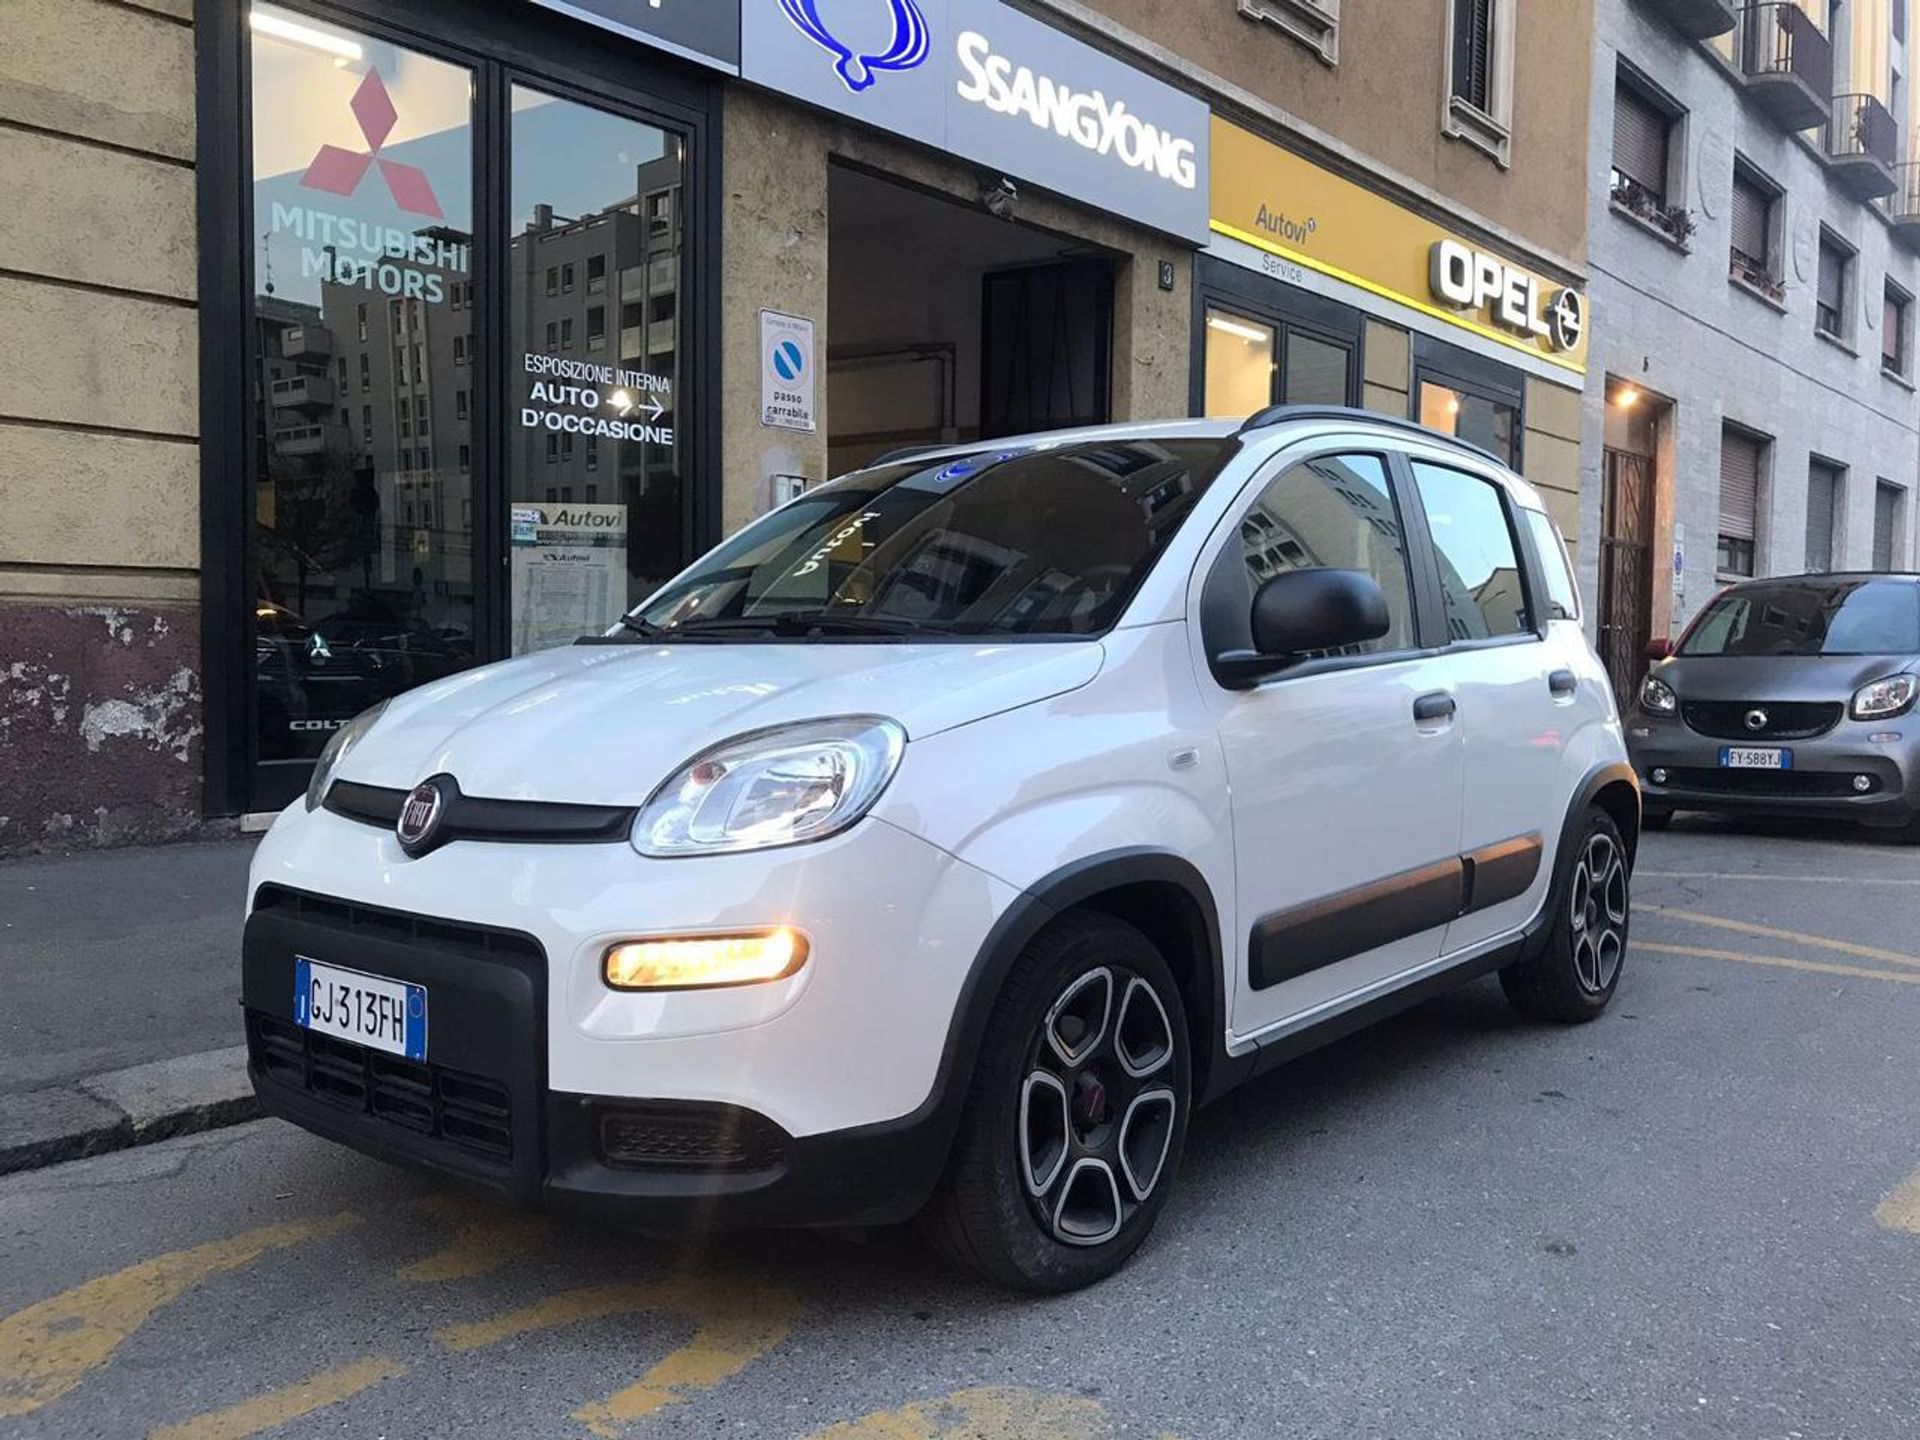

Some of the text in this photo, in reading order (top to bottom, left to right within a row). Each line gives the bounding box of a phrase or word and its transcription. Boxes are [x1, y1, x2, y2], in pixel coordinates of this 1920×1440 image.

[957, 31, 1196, 189] SSANGYONG
[272, 201, 468, 273] MITSUBISHI
[1255, 203, 1308, 245] Autovi
[301, 247, 444, 303] MOTORS
[1163, 264, 1172, 285] 3
[1262, 253, 1303, 283] Service
[1438, 239, 1551, 337] OPEL
[524, 353, 671, 394] ESPOSIZIONE INTERNA
[530, 381, 599, 408] AUTO
[773, 391, 802, 404] passo
[521, 408, 673, 445] D'OCCASIONE
[767, 405, 809, 420] carrabile
[552, 509, 623, 528] Autovi
[289, 719, 350, 731] COLT
[404, 800, 433, 828] FIAT
